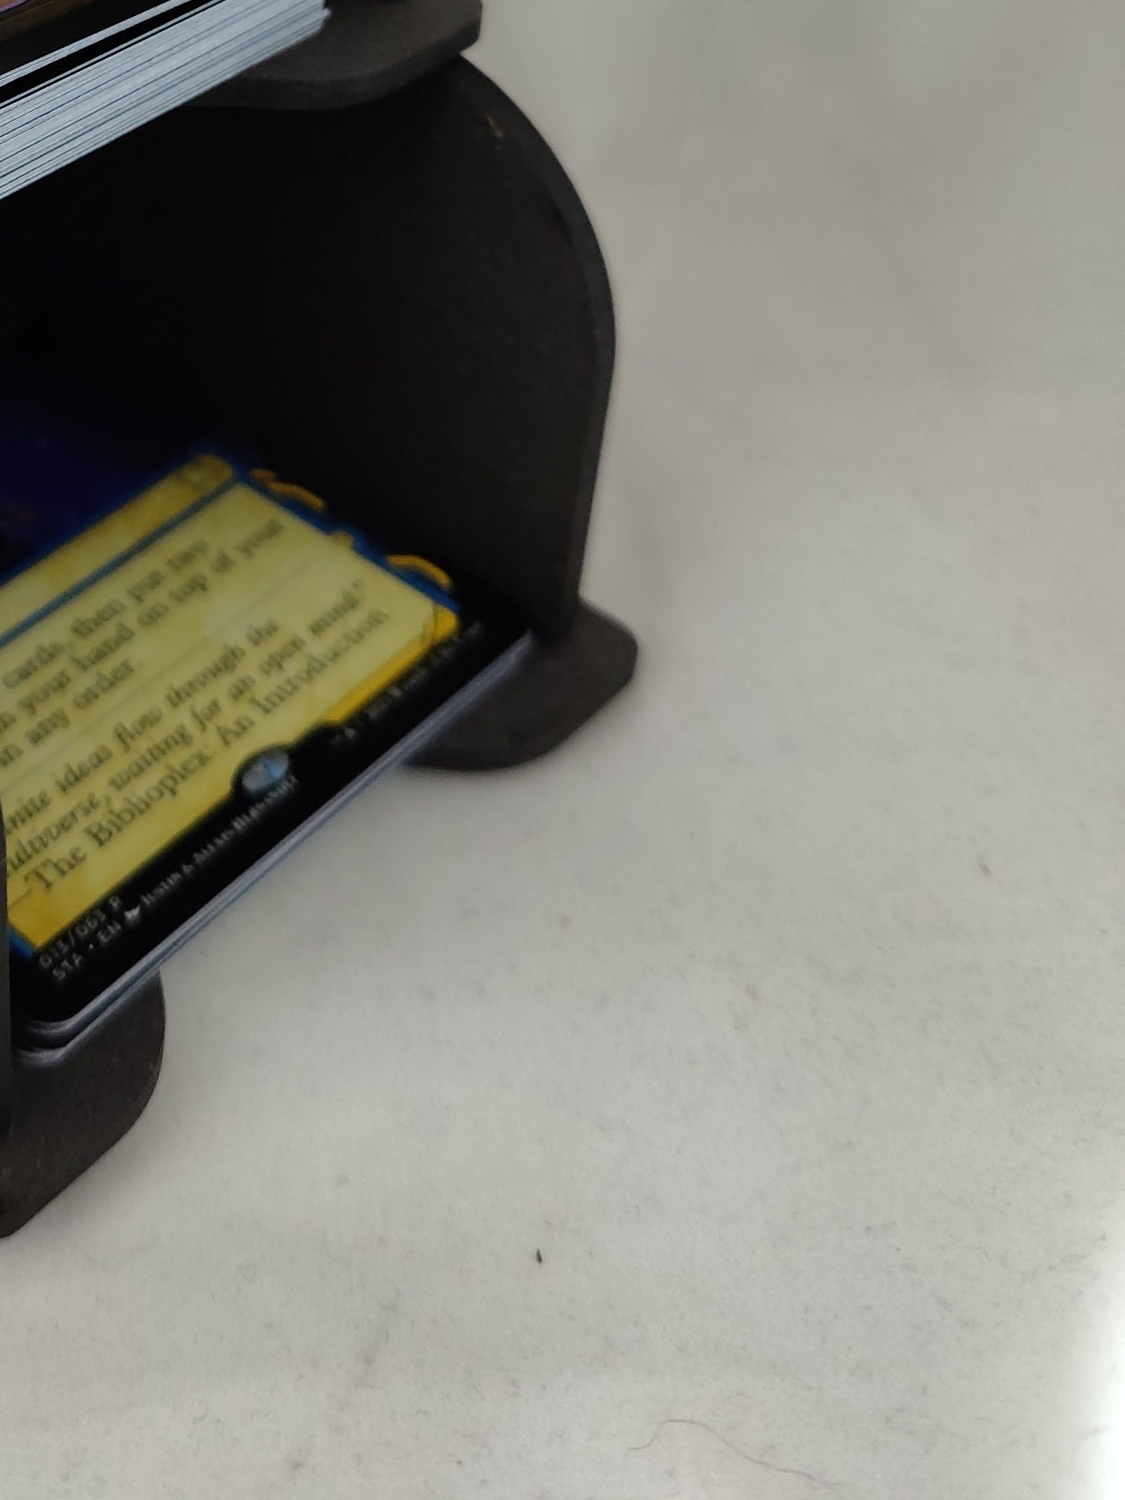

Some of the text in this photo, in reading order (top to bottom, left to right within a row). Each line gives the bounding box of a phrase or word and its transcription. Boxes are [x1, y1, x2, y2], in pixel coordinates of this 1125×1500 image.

[70, 599, 126, 639] then
[70, 622, 136, 673] hand
[52, 744, 113, 796] ideas
[113, 706, 163, 753] flow
[164, 643, 246, 710] through
[245, 617, 279, 648] the
[215, 714, 256, 748] An
[249, 608, 391, 717] Introduction
[107, 723, 194, 793] waiting
[189, 698, 222, 735] for
